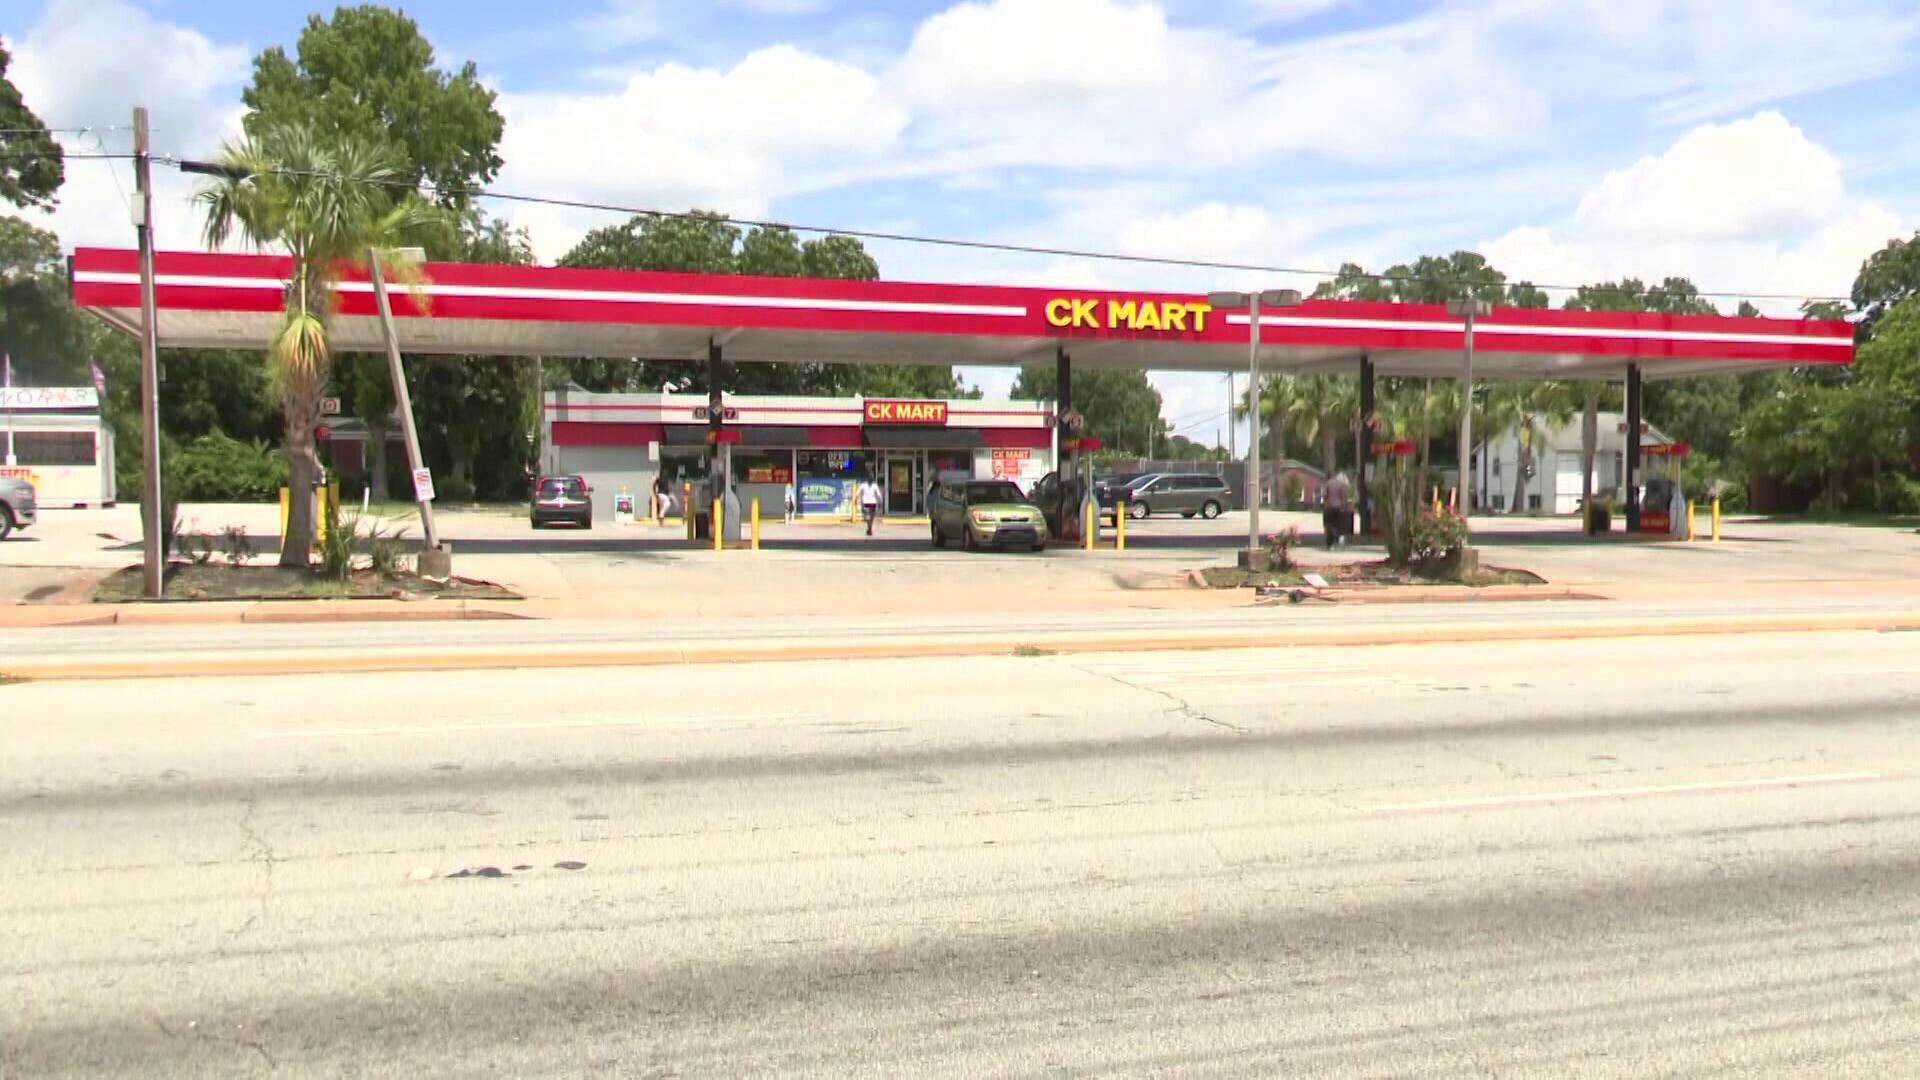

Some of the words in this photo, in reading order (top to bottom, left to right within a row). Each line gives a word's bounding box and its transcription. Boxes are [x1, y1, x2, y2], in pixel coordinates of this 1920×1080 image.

[1045, 298, 1099, 328] CK
[1107, 300, 1212, 332] MART
[868, 403, 892, 419] CK
[896, 403, 945, 420] MART
[1005, 450, 1029, 459] MART
